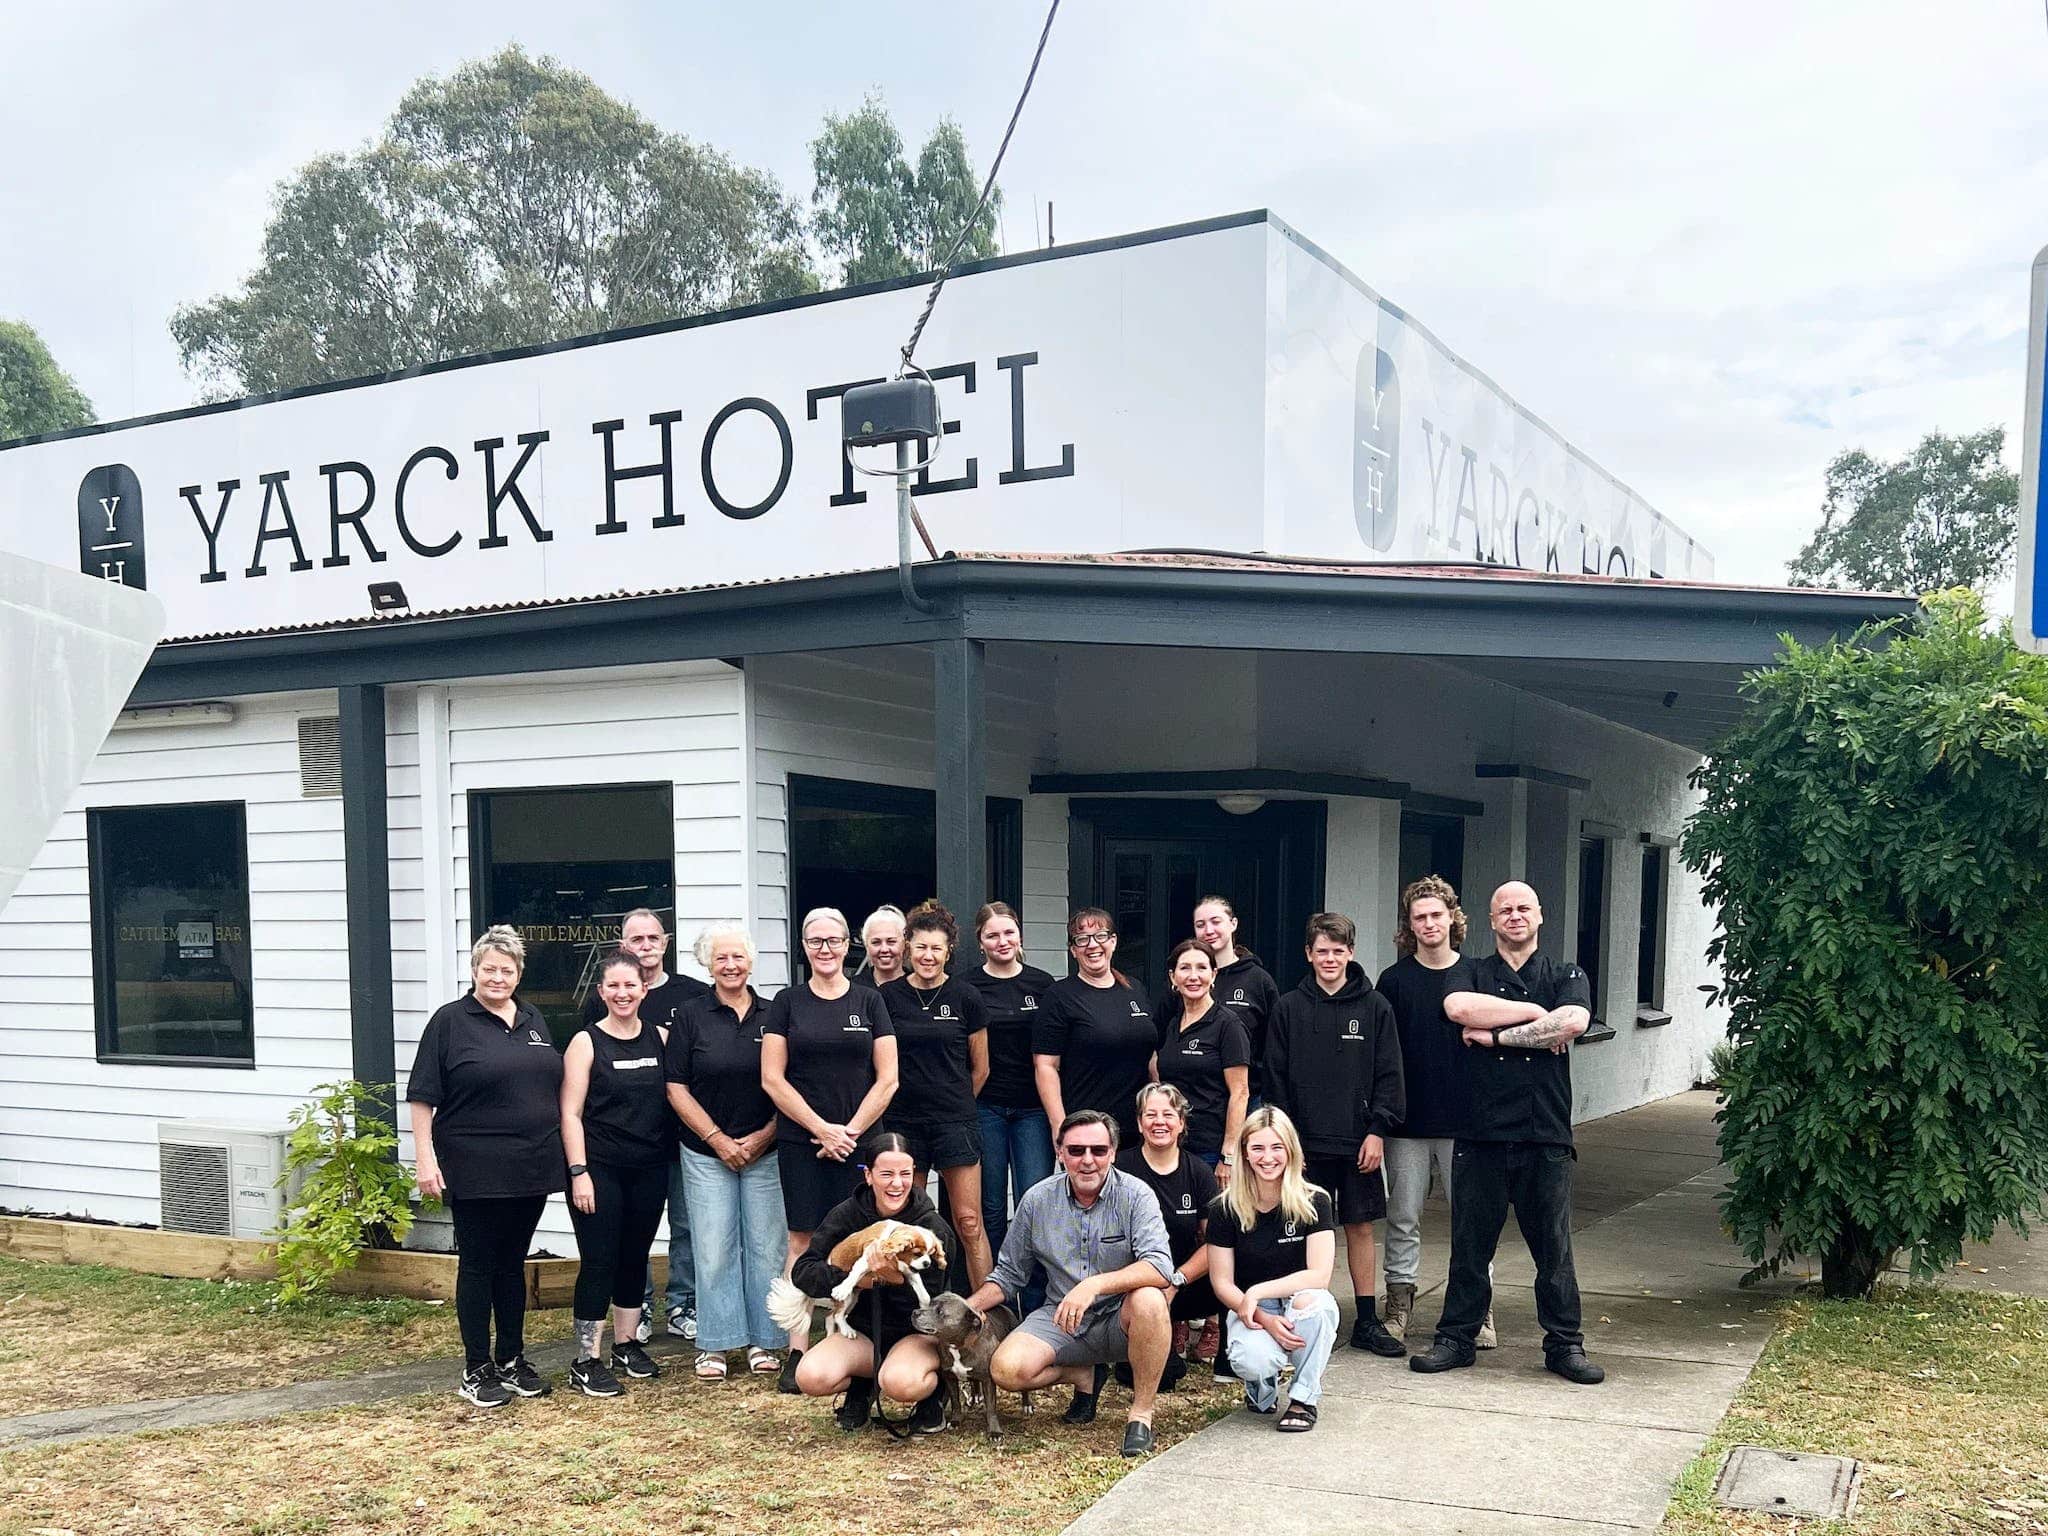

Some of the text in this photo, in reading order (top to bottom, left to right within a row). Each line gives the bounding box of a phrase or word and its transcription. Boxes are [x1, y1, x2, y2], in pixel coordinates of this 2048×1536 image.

[1371, 386, 1385, 431] Y
[179, 351, 1076, 584] YARCK HOTEL
[1366, 465, 1384, 513] H
[1421, 416, 1568, 573] YARCK
[98, 496, 121, 532] Y
[119, 926, 242, 942] CATTLEM BAR
[183, 931, 209, 944] ATM
[516, 925, 622, 942] ATTLEMAN'S
